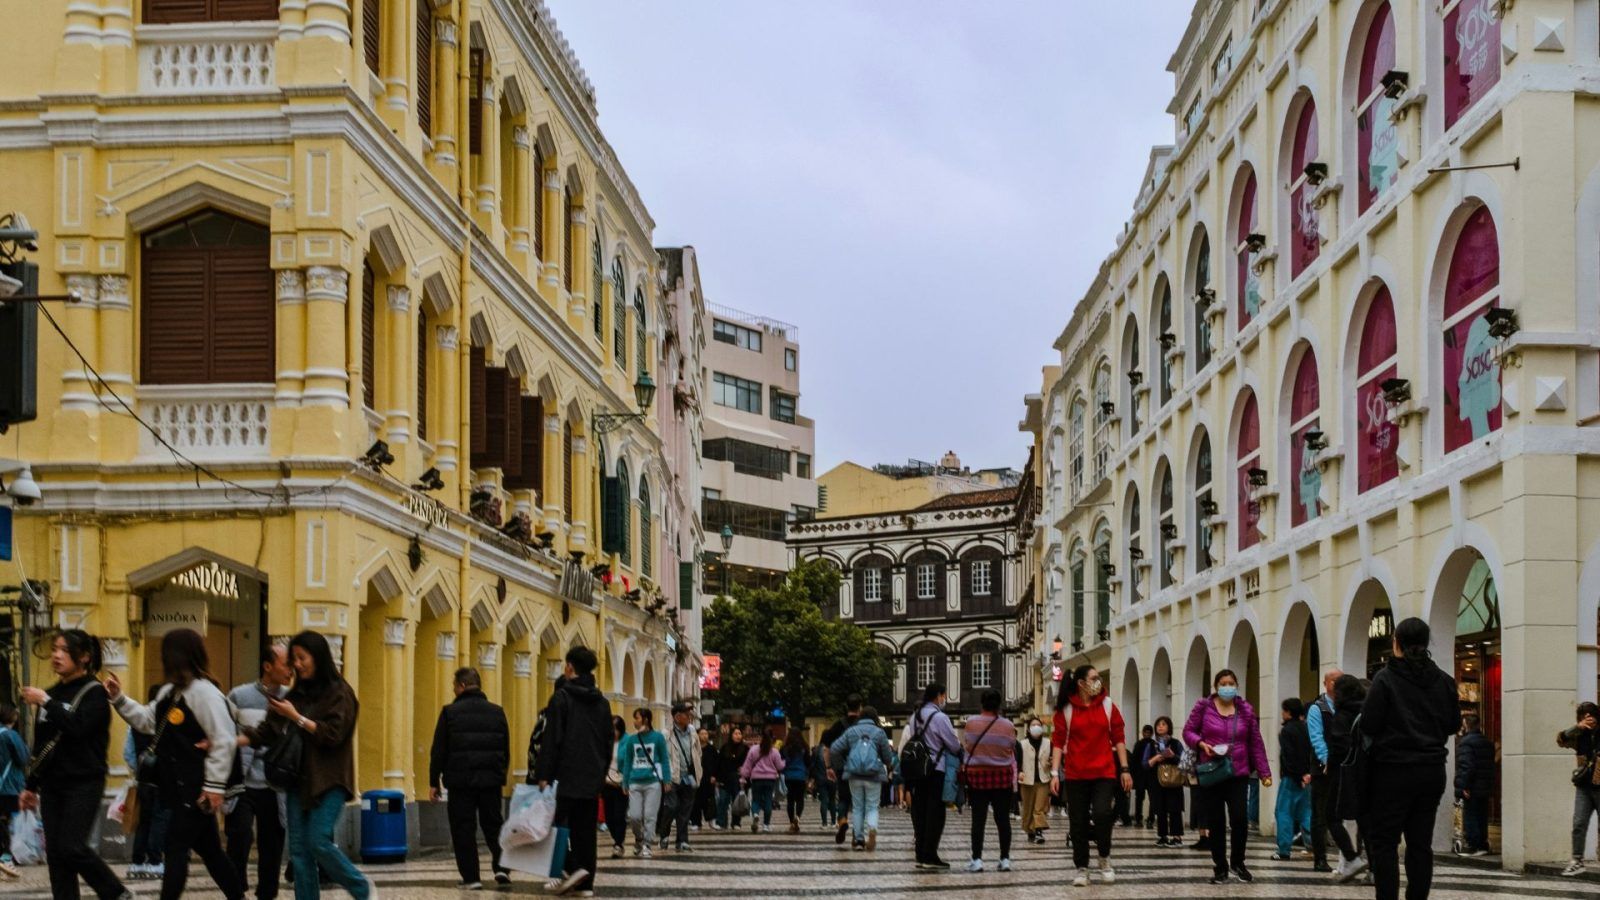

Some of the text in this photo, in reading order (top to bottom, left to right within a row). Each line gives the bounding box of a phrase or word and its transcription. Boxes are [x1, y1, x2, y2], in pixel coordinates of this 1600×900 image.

[409, 494, 449, 531] PANDORA
[170, 562, 239, 599] ANDORA
[150, 611, 198, 623] ANDORA
